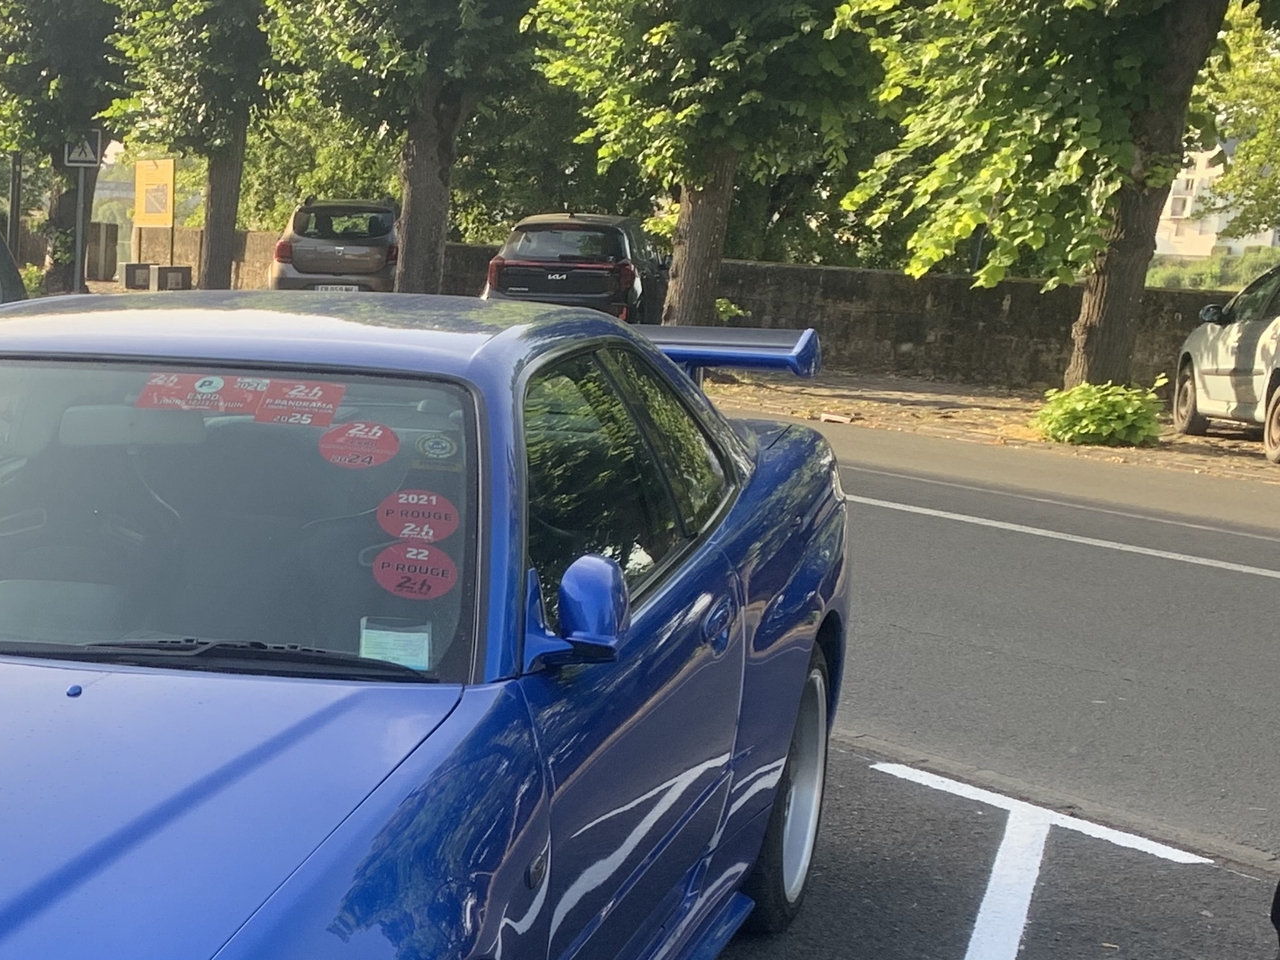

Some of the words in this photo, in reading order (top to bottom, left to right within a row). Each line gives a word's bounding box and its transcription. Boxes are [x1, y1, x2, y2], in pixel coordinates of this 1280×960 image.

[198, 380, 214, 389] P
[187, 392, 220, 400] EXPO
[274, 399, 333, 410] PANORAMA
[273, 412, 313, 424] 2025
[330, 453, 374, 466] 2024
[398, 493, 437, 505] 2021
[385, 509, 395, 517] P
[400, 509, 452, 521] ROUGE
[405, 547, 429, 560] 22
[381, 562, 390, 570] P
[396, 563, 450, 578] ROUGE
